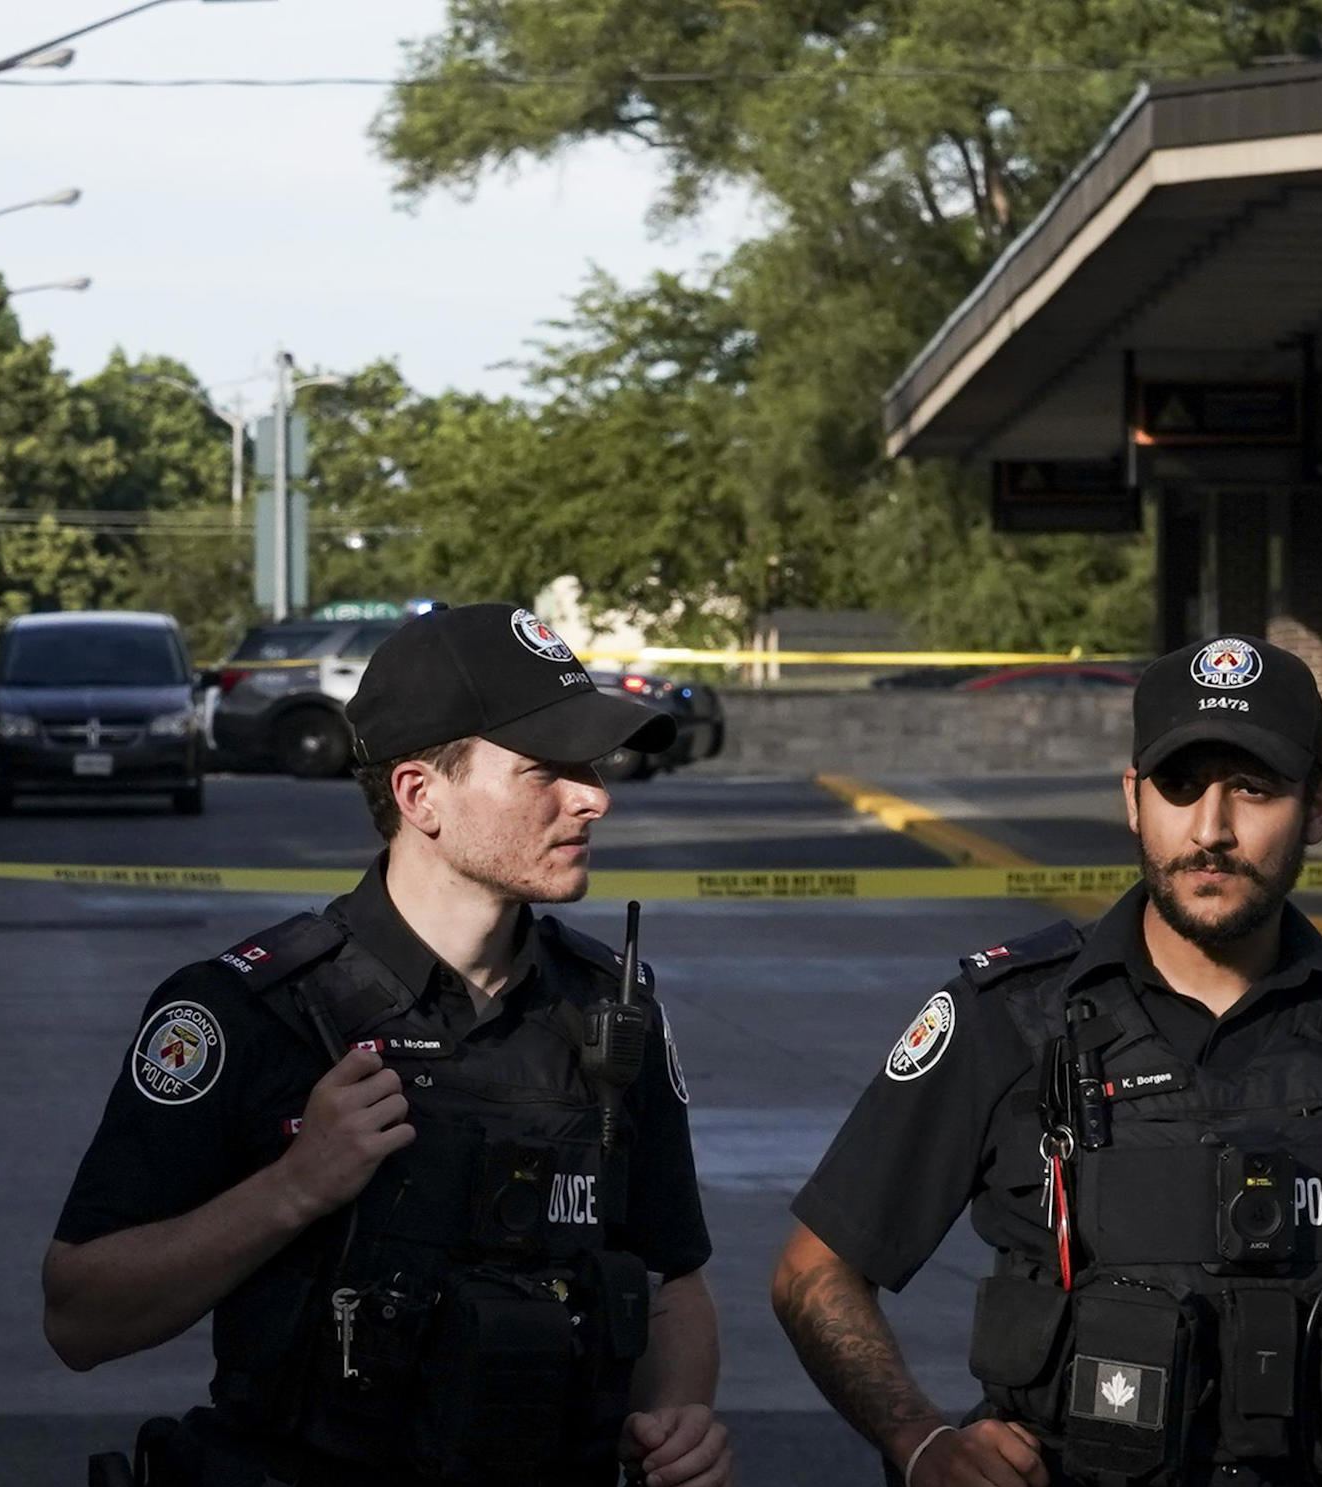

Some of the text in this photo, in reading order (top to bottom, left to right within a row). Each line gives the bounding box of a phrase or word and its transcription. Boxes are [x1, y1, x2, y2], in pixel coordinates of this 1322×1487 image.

[1206, 638, 1253, 652] TORONTO
[1204, 672, 1245, 686] POLICE
[1198, 697, 1249, 712] 12472
[166, 1008, 218, 1046] TORONTO
[390, 1039, 440, 1049] B. McCann
[141, 1061, 183, 1095] POLICE
[1122, 1073, 1172, 1088] K. Borges
[548, 1172, 598, 1224] OLICE
